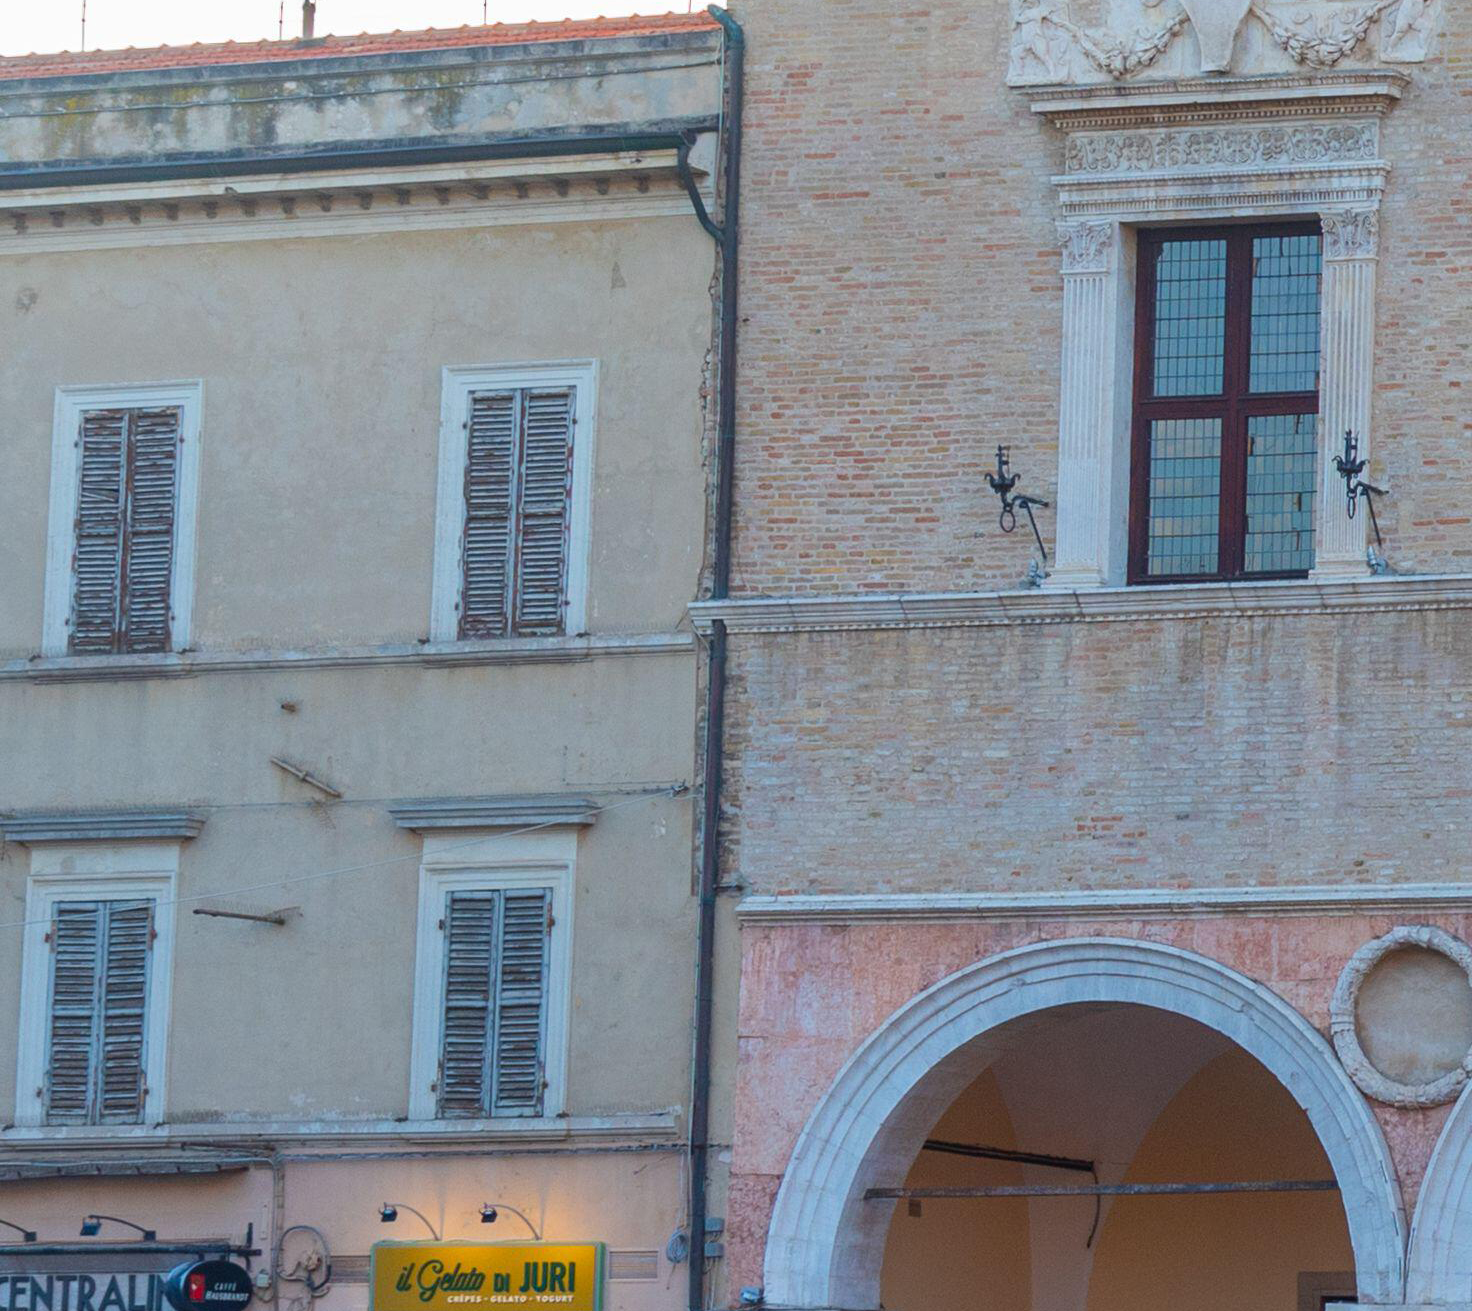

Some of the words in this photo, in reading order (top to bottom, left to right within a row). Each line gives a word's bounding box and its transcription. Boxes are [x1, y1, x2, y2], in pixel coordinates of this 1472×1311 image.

[396, 1263, 416, 1292] il
[416, 1259, 487, 1302] Gelato
[493, 1272, 511, 1293] DI
[519, 1261, 577, 1293] JURI
[490, 1295, 528, 1303] GELATO
[535, 1295, 574, 1303] YOGURT
